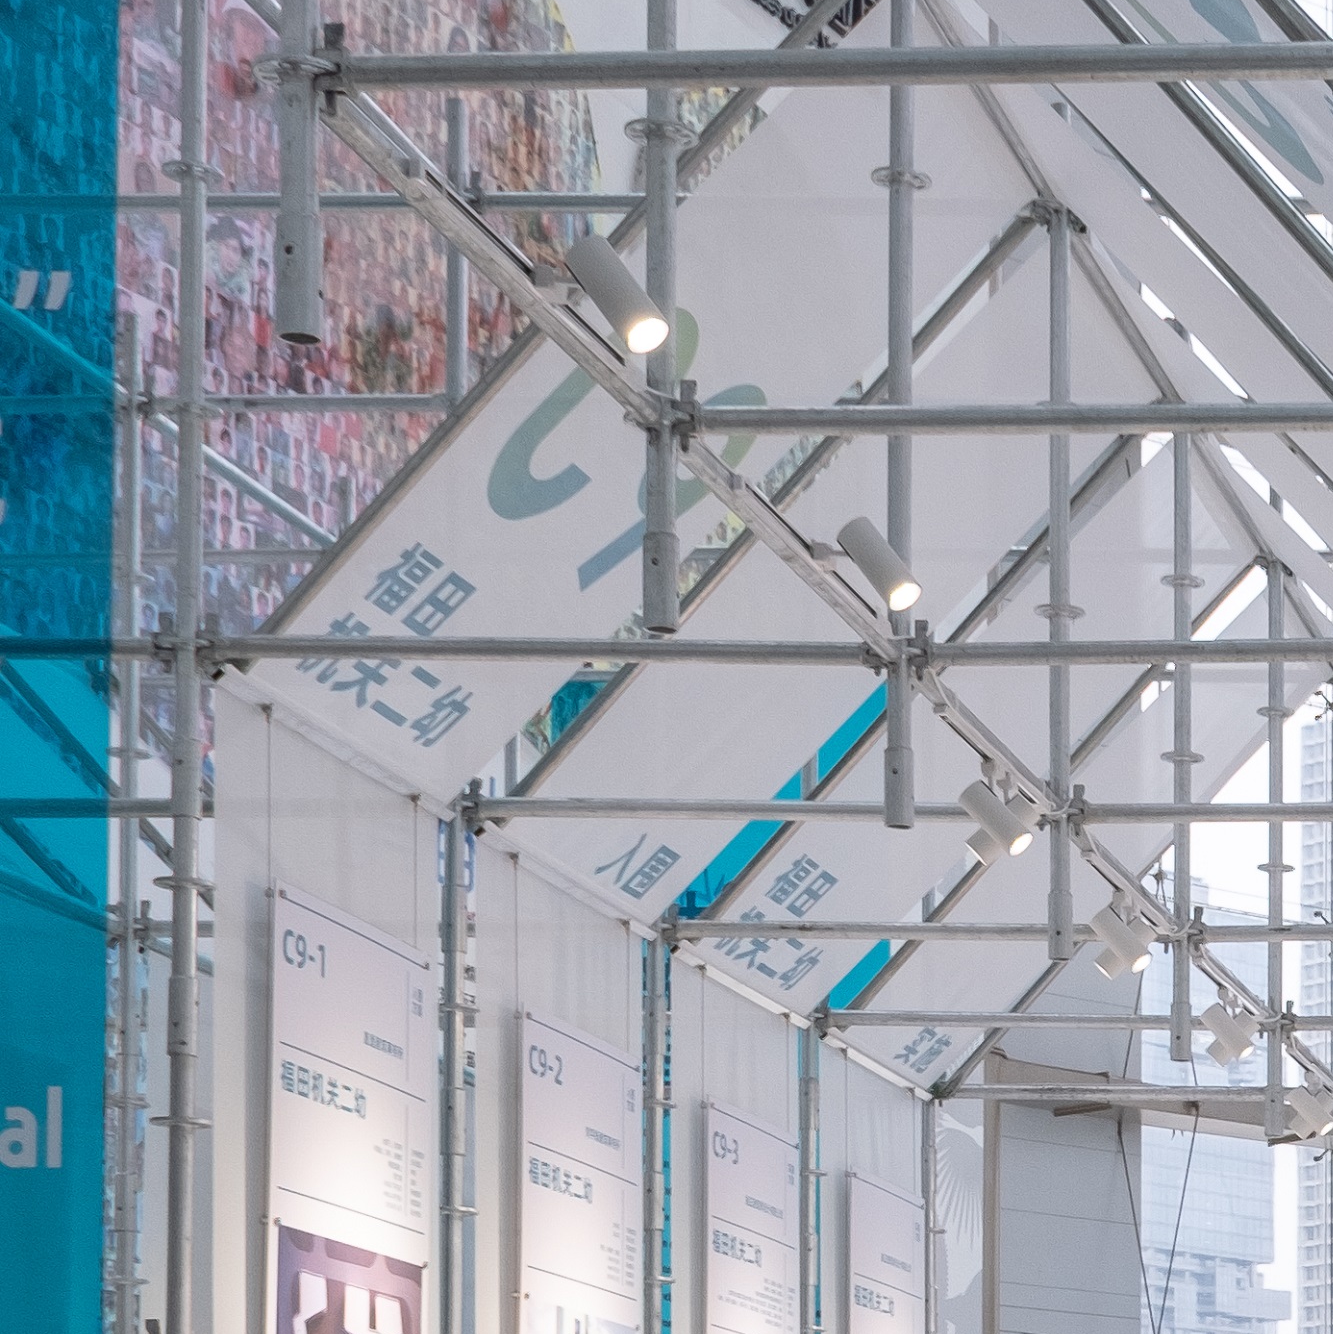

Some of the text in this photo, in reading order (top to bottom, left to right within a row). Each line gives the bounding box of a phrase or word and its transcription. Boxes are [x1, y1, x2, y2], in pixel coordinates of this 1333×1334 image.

[365, 542, 477, 636] 福田
[295, 611, 472, 747] 机关二幼
[594, 833, 682, 900] 入围
[765, 854, 840, 918] 福田
[281, 928, 328, 979] C9-1
[280, 1059, 368, 1121] 福田机关二幼
[528, 1044, 564, 1086] C9-2
